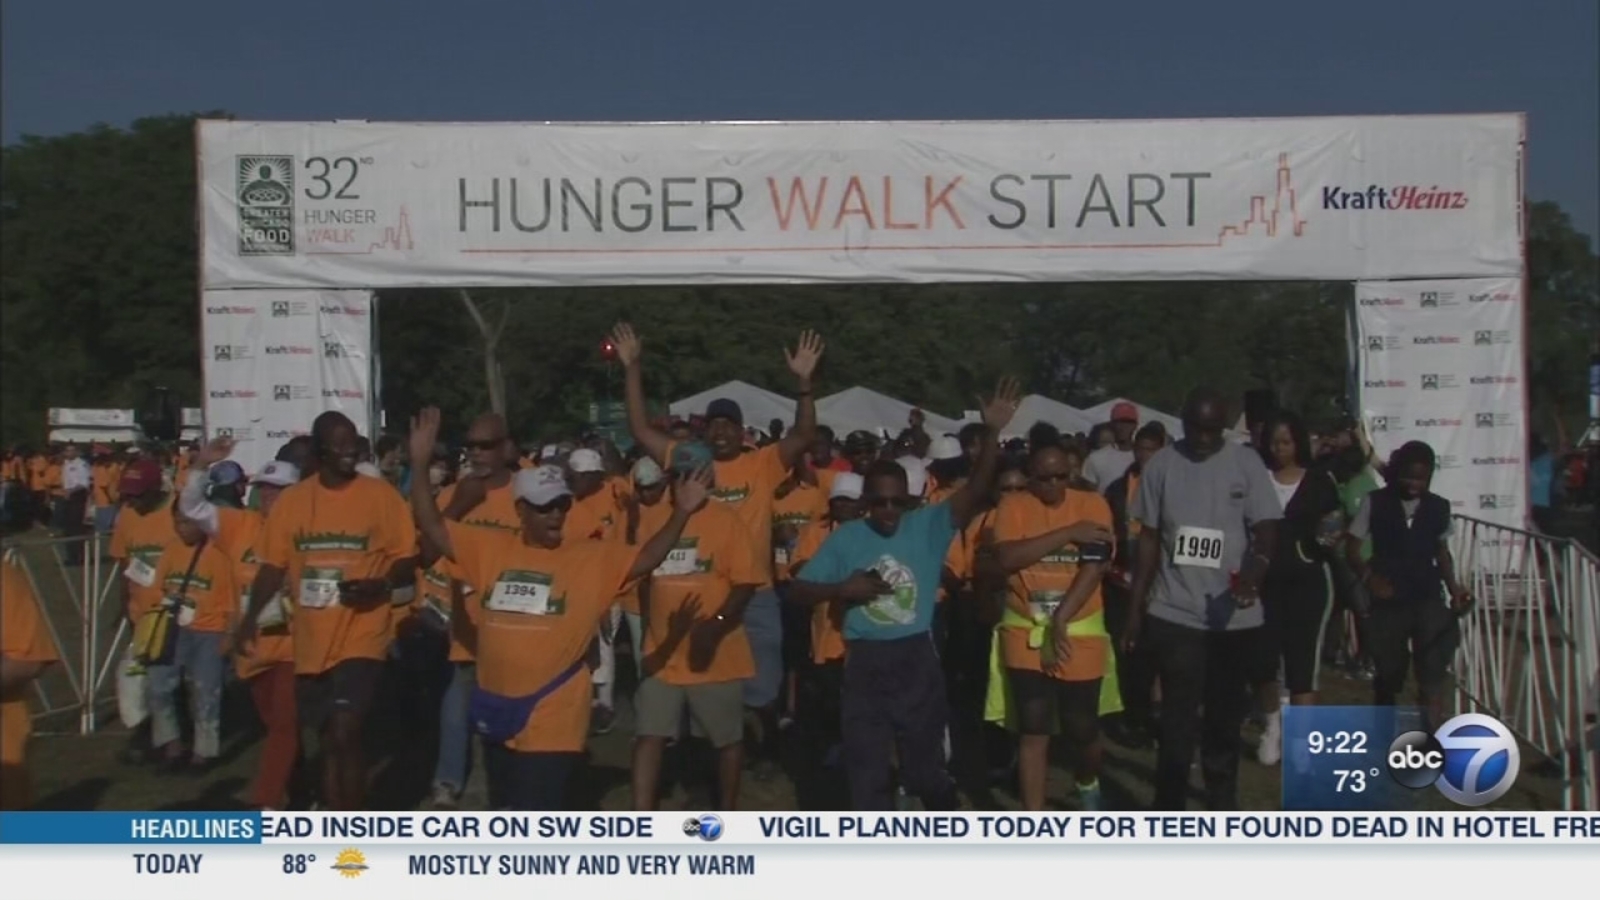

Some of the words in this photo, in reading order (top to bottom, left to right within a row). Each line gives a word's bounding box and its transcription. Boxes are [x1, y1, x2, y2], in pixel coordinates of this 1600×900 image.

[458, 176, 745, 233] HUNGER
[767, 174, 967, 230] WALK
[987, 172, 1212, 230] START
[304, 209, 376, 224] HUNGER
[306, 228, 356, 243] WALK
[1177, 534, 1221, 560] 1990
[504, 584, 536, 596] 1394
